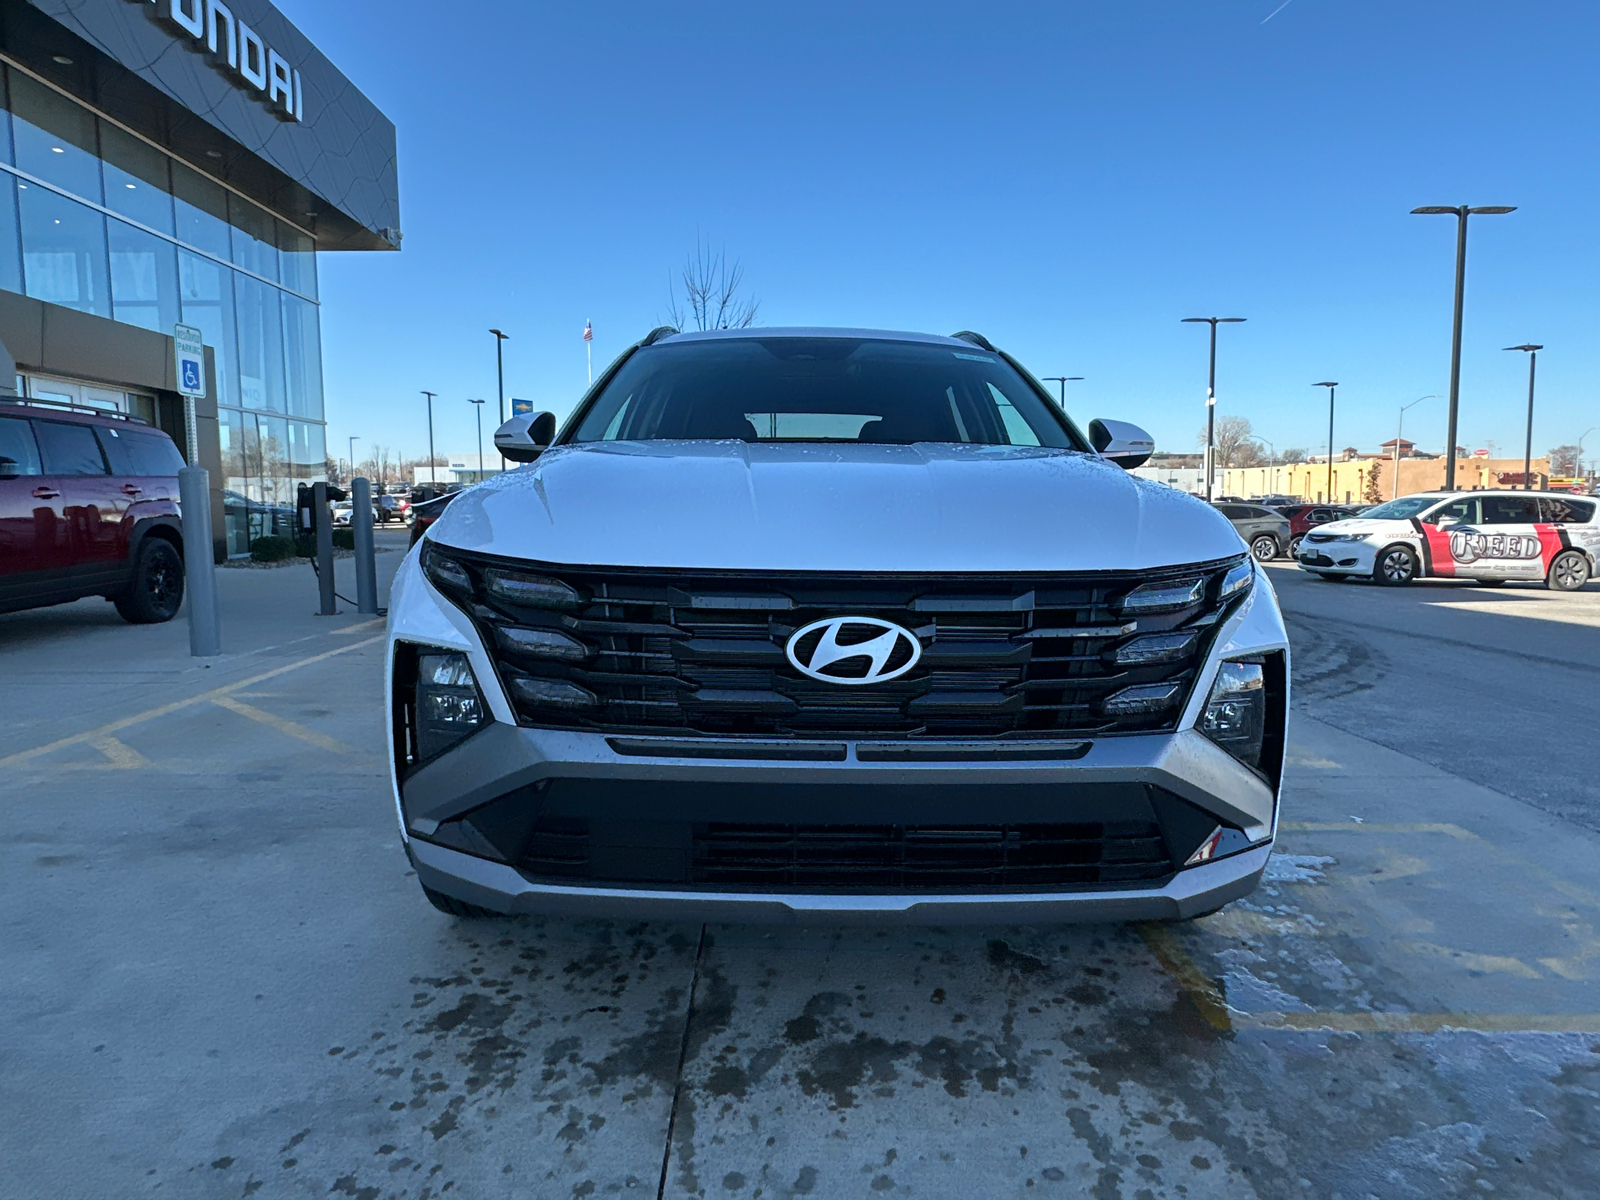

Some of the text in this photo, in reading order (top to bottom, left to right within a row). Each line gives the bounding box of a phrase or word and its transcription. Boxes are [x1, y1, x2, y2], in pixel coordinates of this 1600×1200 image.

[150, 0, 303, 122] UNDAI
[178, 342, 200, 355] PARKING
[1453, 531, 1540, 559] REED
